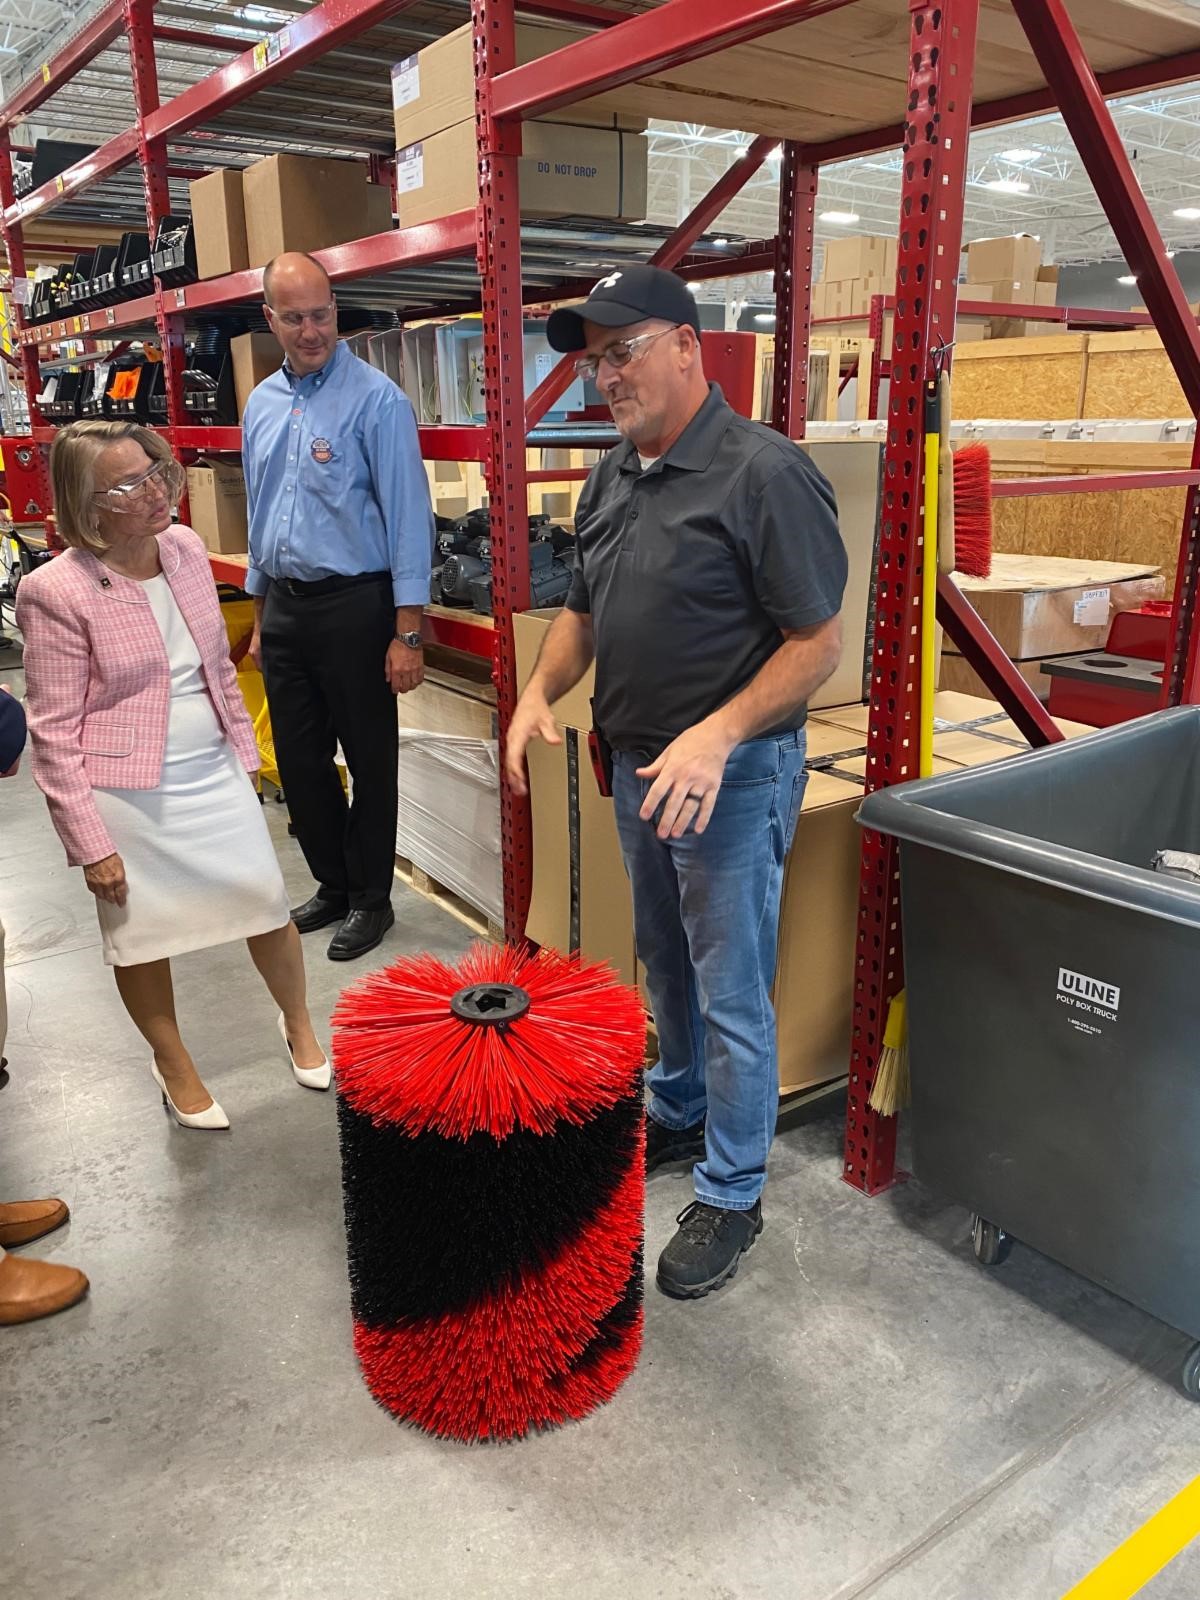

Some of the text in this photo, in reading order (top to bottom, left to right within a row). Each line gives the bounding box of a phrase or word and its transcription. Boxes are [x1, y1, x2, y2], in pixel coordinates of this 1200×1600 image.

[537, 161, 597, 178] DO NOT DROP
[1062, 972, 1116, 1005] ULINE
[1056, 993, 1117, 1021] POLY BOX TRUCK
